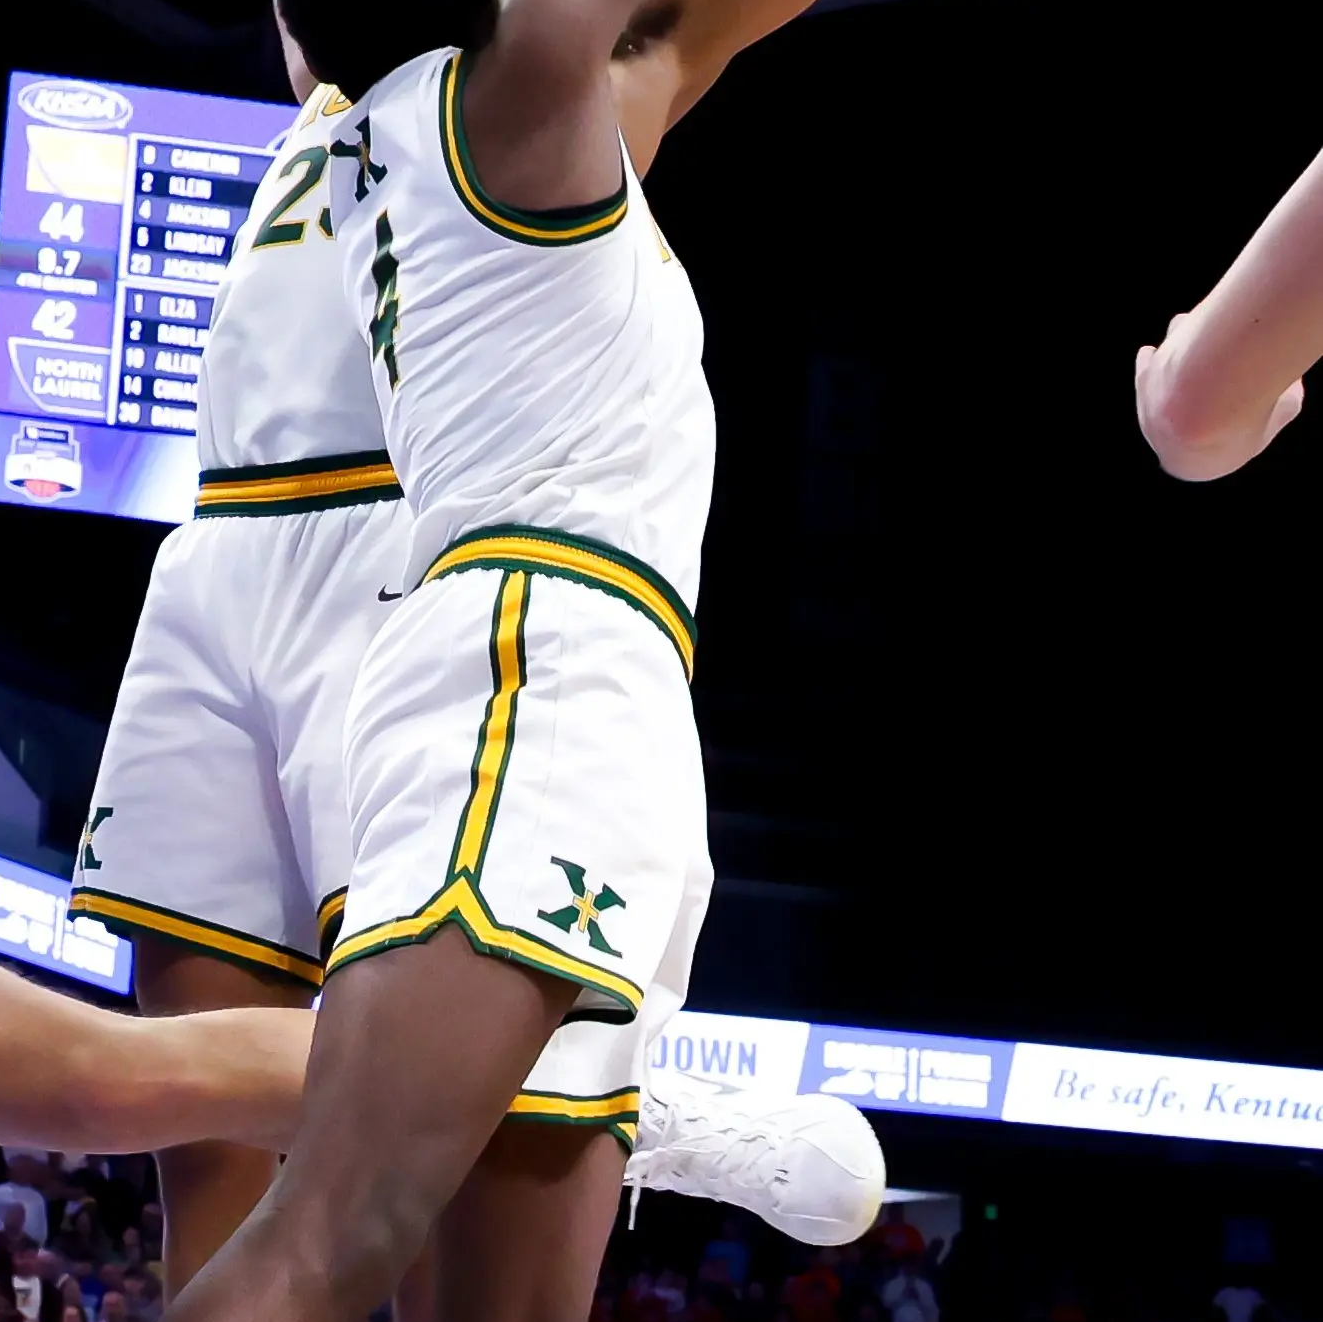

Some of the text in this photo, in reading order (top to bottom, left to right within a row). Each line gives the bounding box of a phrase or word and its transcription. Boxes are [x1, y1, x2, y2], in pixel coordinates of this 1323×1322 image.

[250, 144, 336, 253] 2
[38, 200, 84, 242] 44
[30, 299, 78, 339] 42
[32, 376, 103, 402] LAUREL
[35, 356, 104, 382] NORTH
[1054, 1068, 1096, 1101] Be
[1107, 1076, 1186, 1118] safe,
